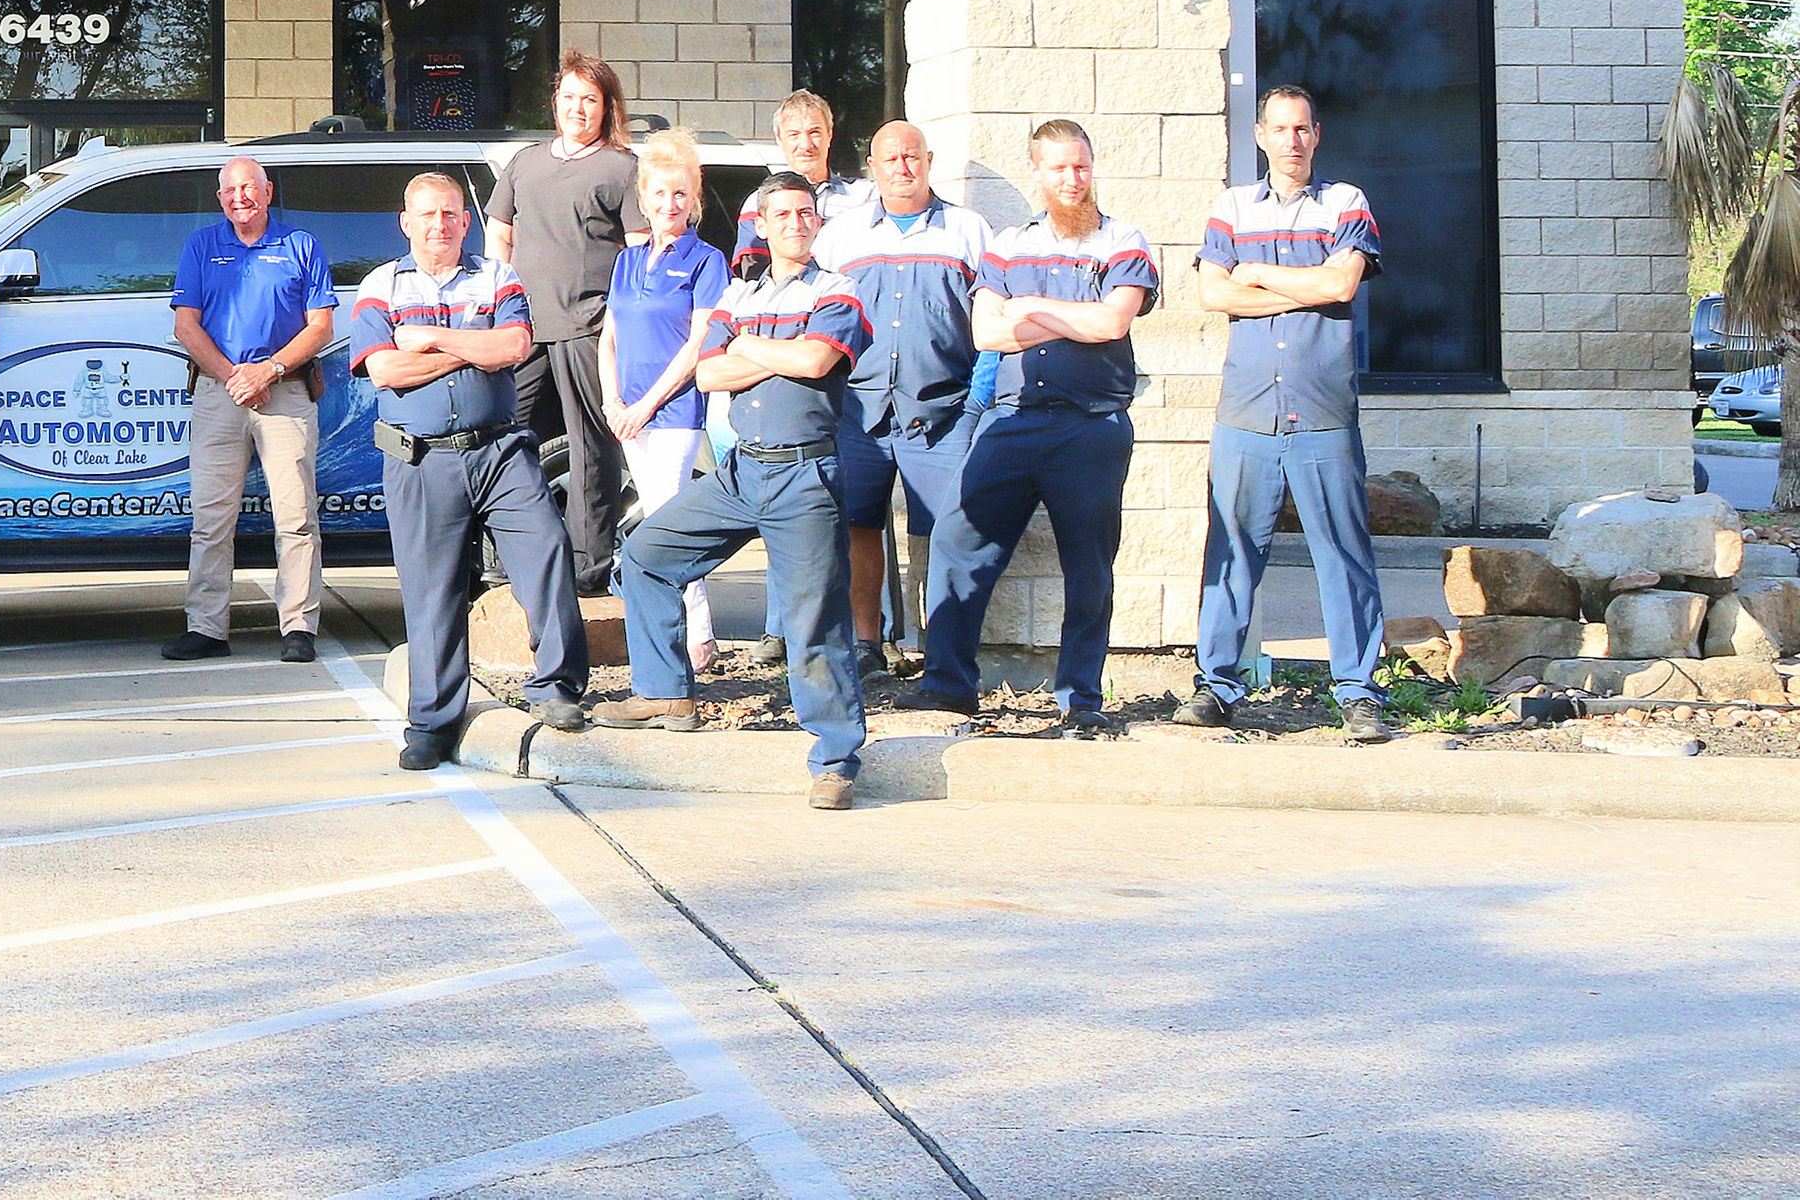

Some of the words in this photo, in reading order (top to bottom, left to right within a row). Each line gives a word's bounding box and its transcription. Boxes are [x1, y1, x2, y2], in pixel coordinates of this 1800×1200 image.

[117, 388, 193, 407] CENTE
[52, 449, 68, 468] Of
[74, 449, 111, 466] Clear
[115, 449, 148, 466] Lake
